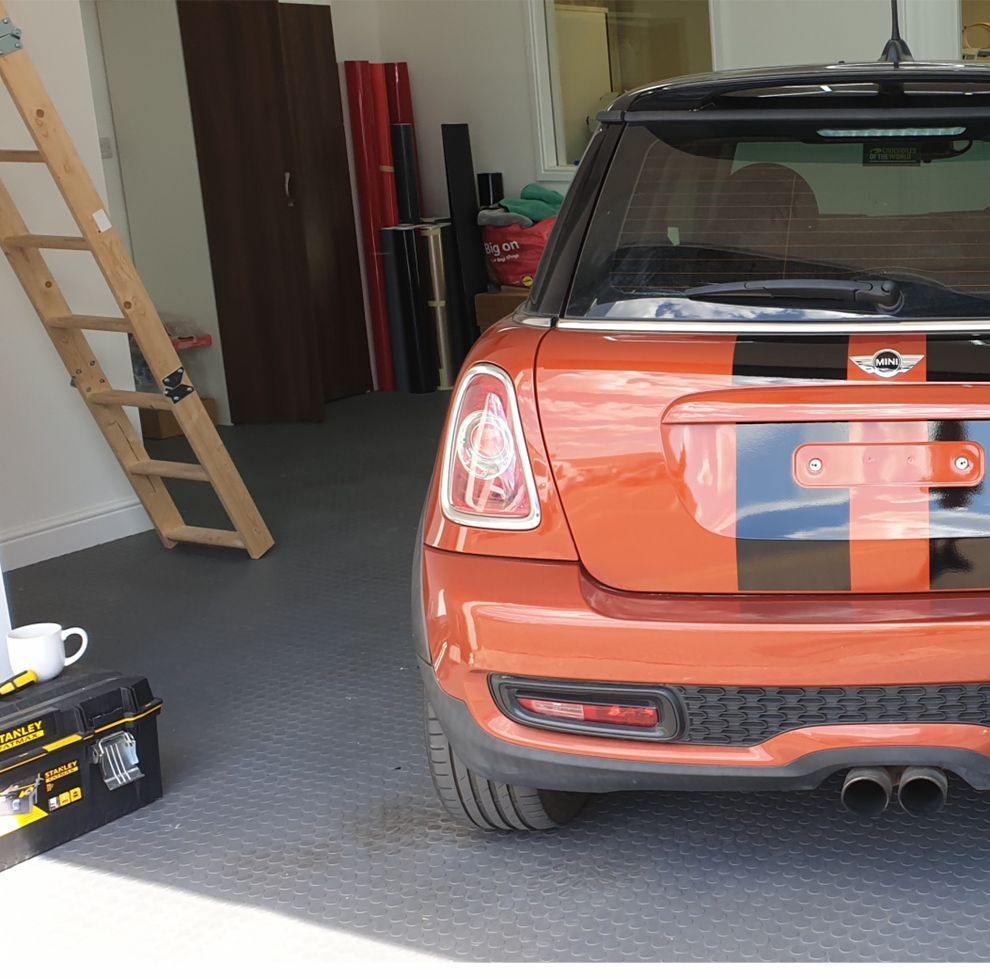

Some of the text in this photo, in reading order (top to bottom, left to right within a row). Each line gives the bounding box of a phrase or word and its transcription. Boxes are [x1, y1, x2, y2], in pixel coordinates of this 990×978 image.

[484, 240, 519, 256] Big on
[875, 357, 898, 366] MINI
[0, 720, 42, 743] TANLEY
[44, 760, 78, 778] STANLEY
